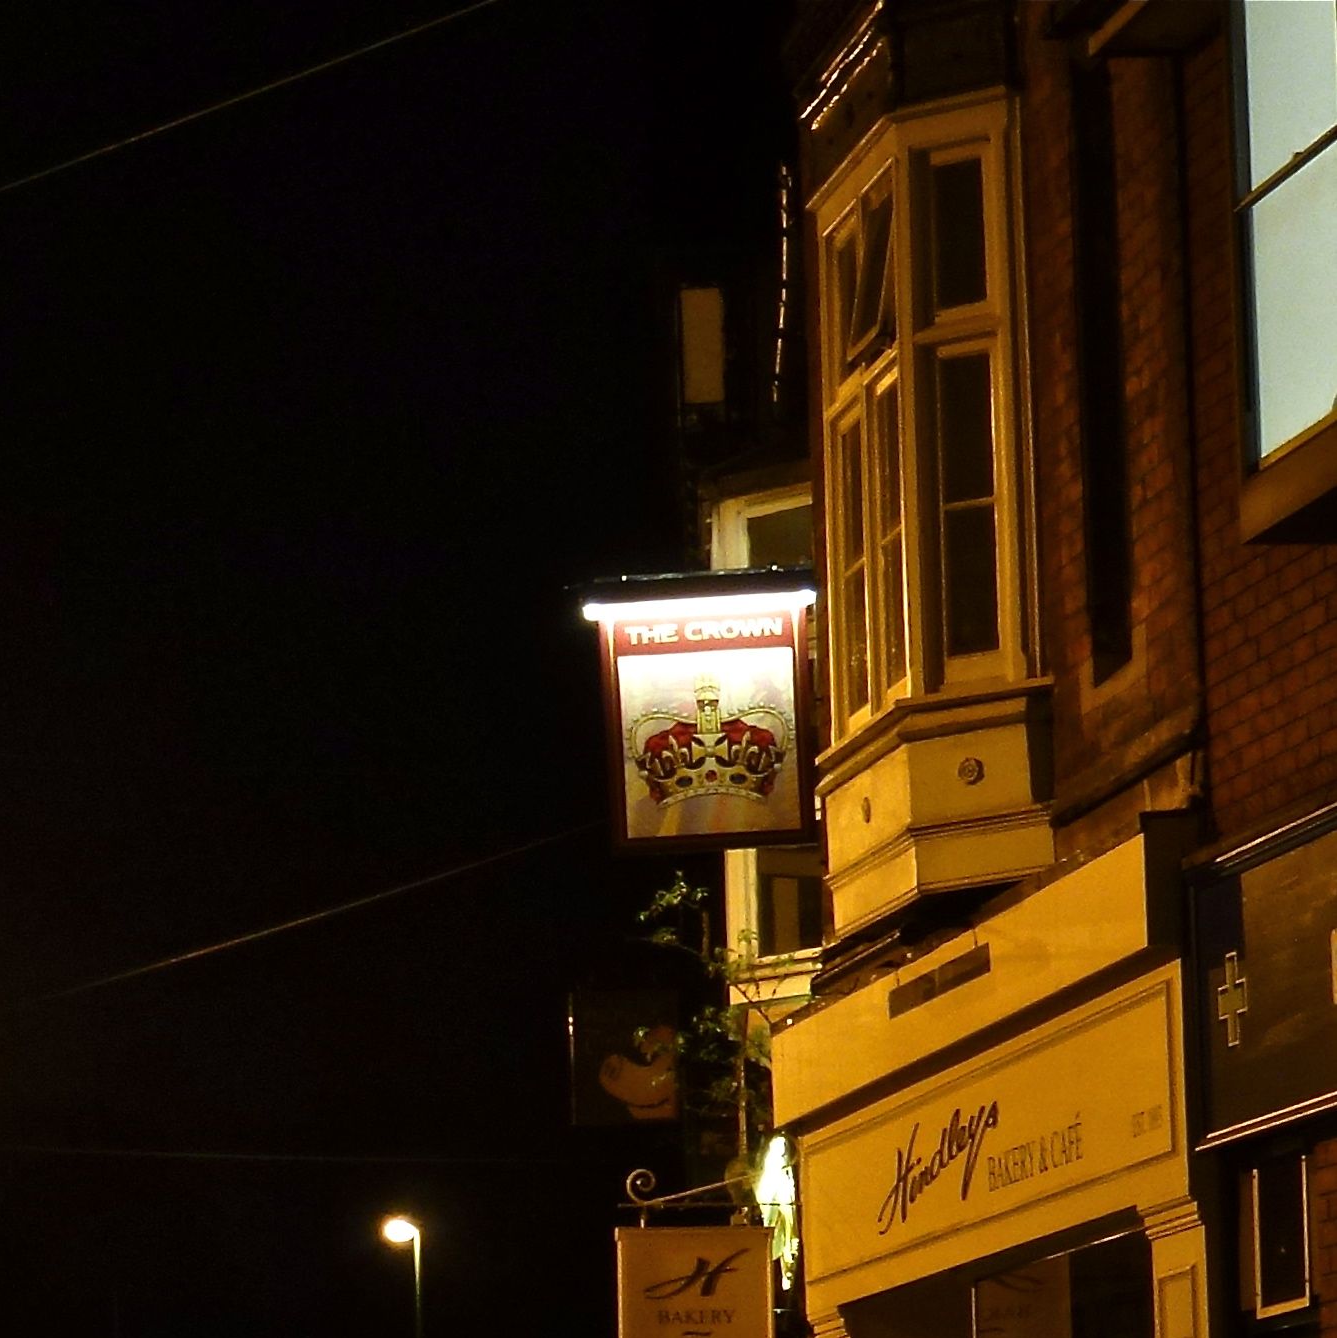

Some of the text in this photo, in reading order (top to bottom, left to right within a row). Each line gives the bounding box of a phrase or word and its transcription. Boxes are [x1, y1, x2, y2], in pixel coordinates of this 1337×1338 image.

[625, 617, 783, 645] THE CROWN
[986, 1142, 1036, 1192] BAKERY
[659, 1310, 734, 1325] BAKERY
